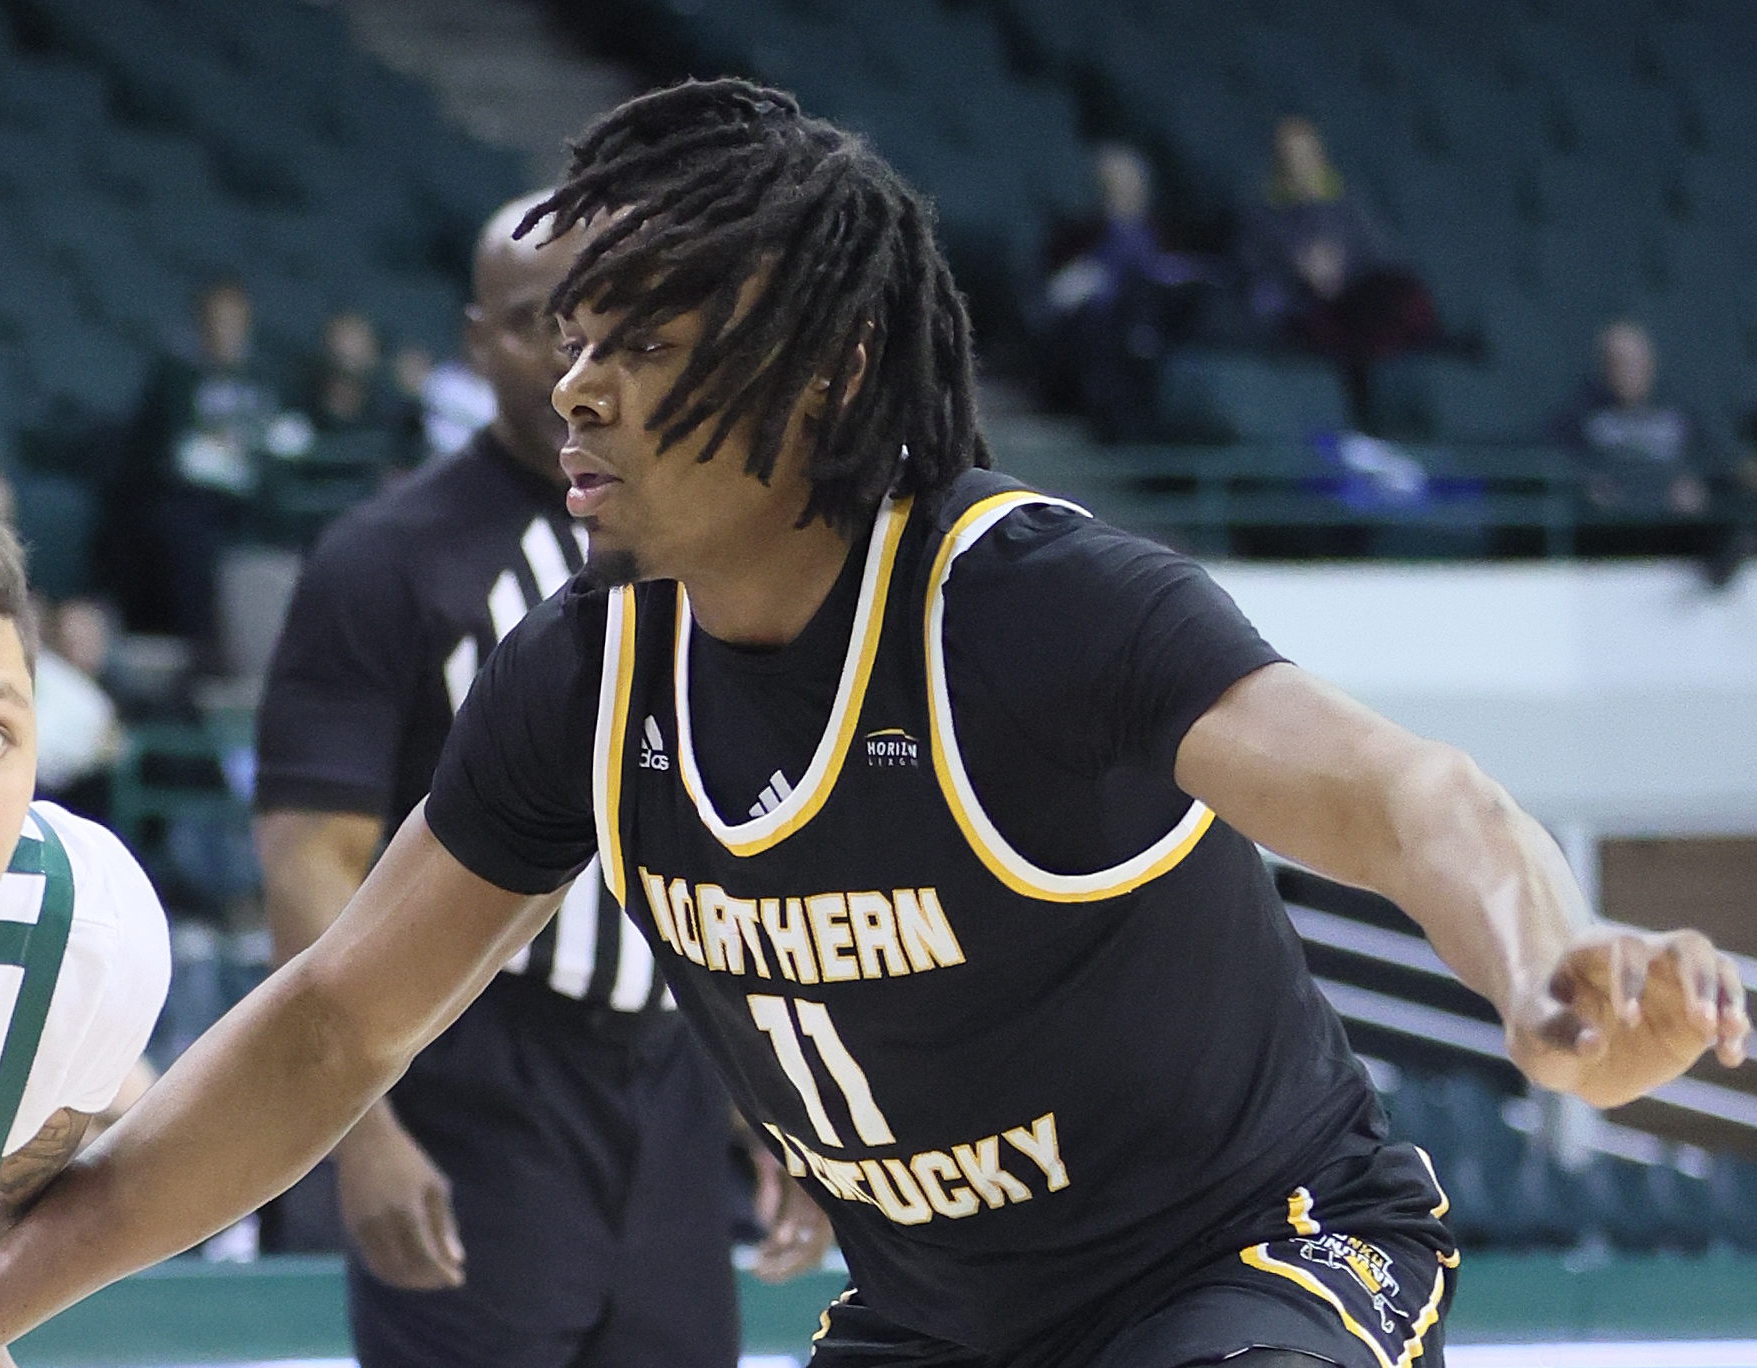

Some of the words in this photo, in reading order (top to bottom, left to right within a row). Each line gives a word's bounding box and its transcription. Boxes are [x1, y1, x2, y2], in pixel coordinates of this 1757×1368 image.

[866, 741, 918, 758] HORIZN
[638, 866, 967, 984] NORTHERN
[746, 993, 897, 1147] 11
